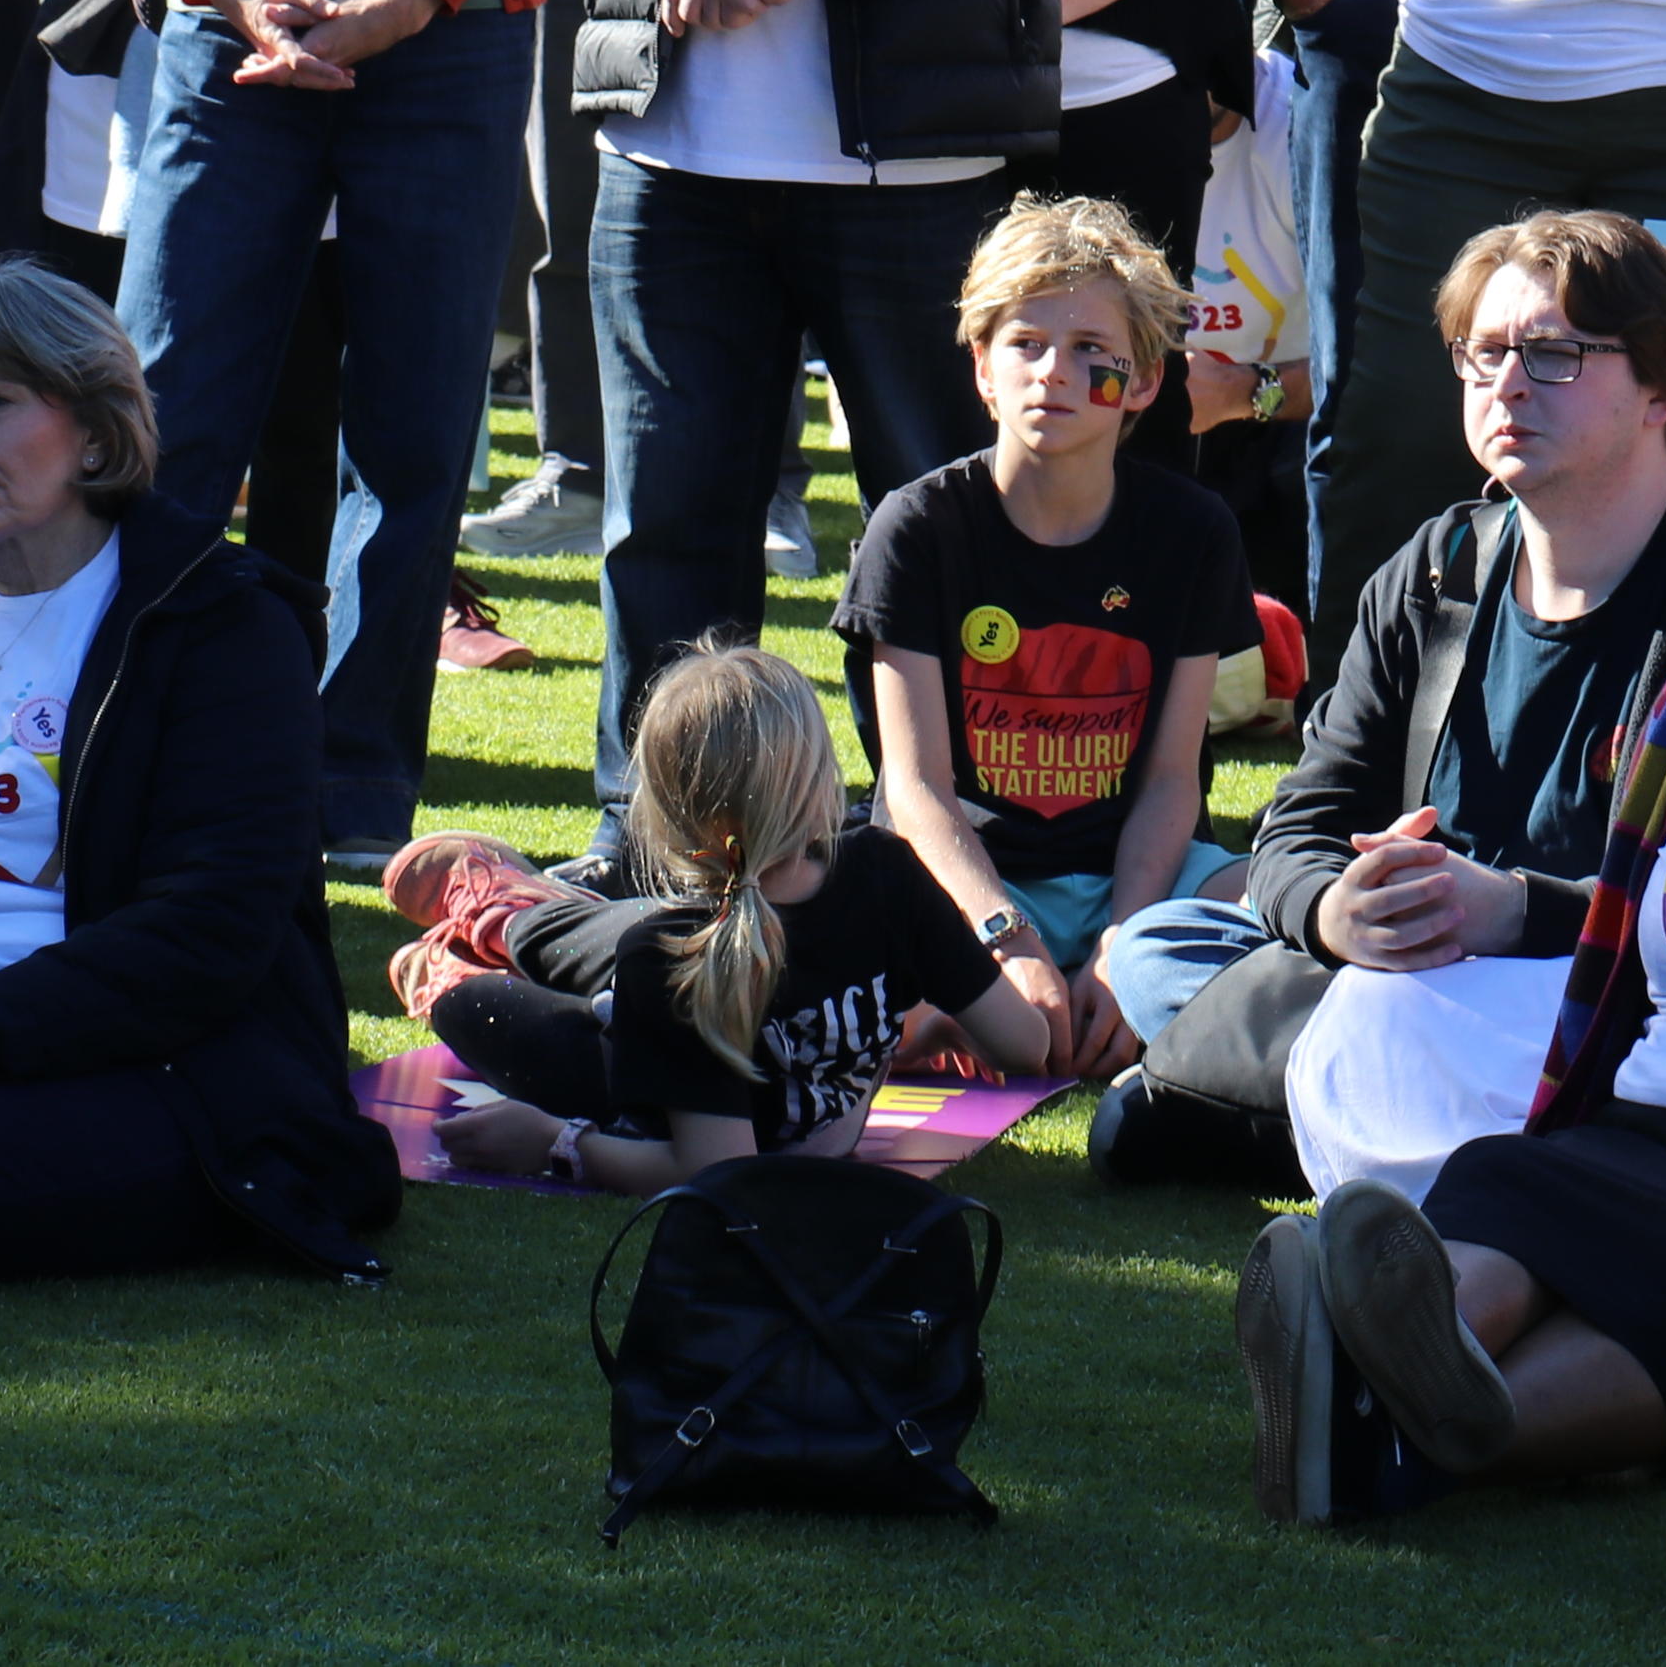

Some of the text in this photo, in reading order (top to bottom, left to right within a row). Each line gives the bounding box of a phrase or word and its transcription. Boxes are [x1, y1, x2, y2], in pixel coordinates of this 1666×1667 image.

[978, 621, 1000, 647] Yes
[32, 706, 57, 738] Yes
[966, 693, 1150, 740] We support
[973, 729, 1131, 769] THE ULURU
[976, 766, 1126, 800] STATEMENT
